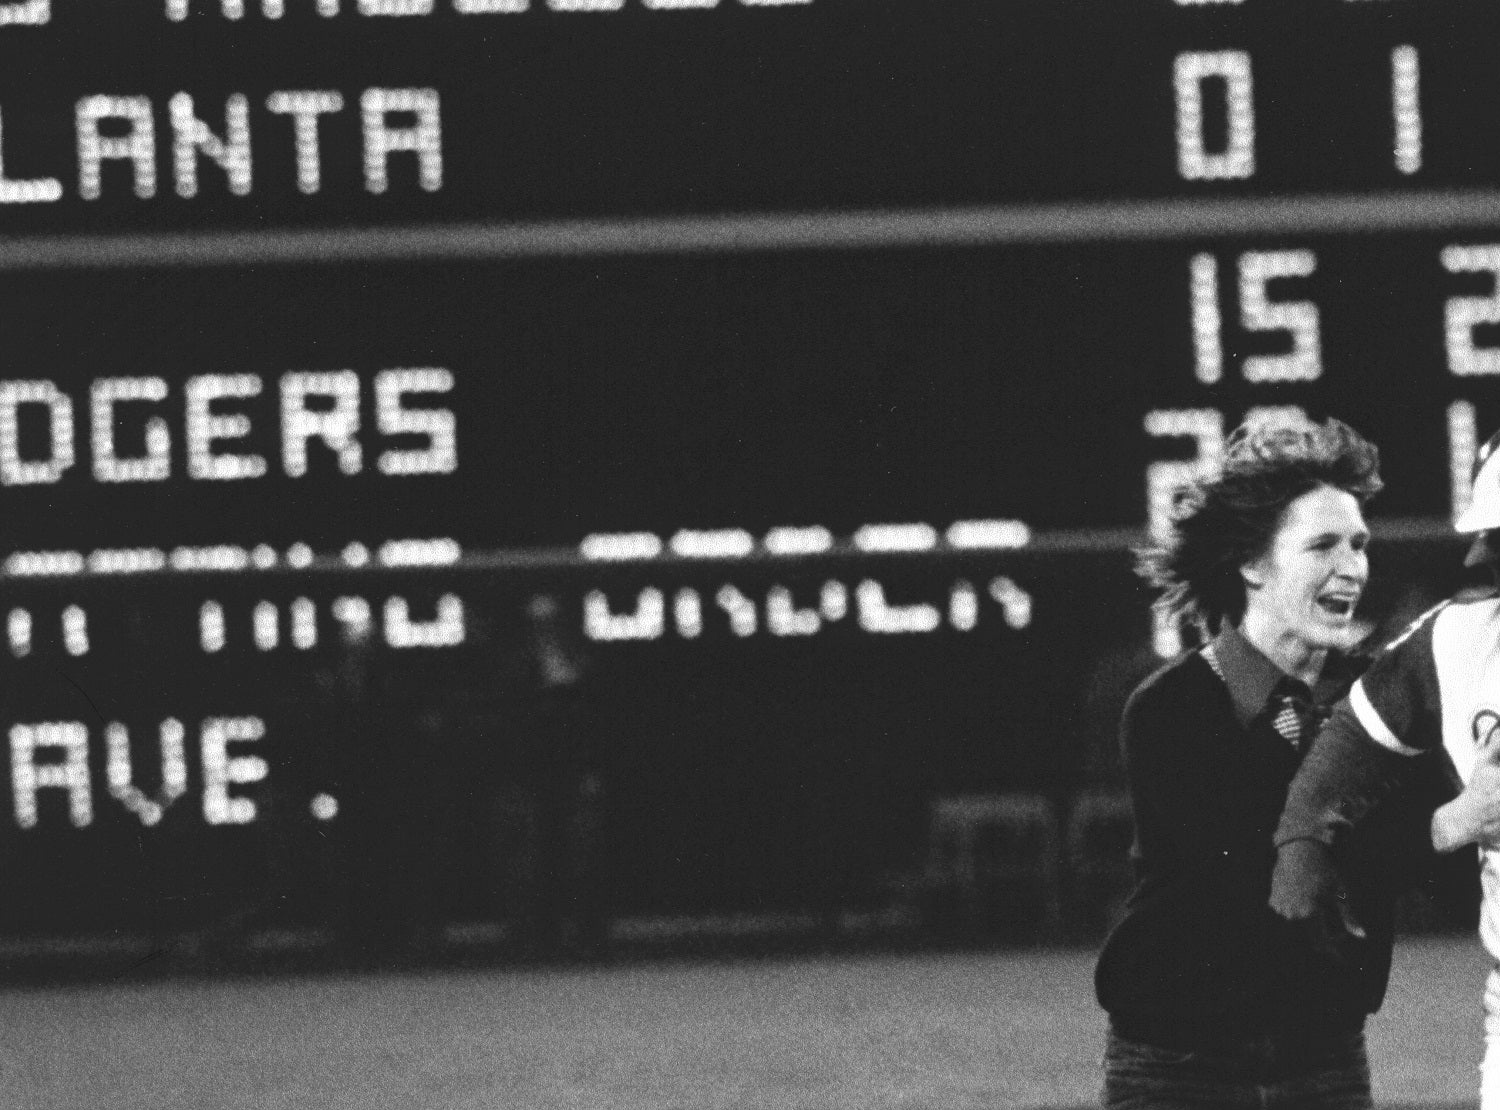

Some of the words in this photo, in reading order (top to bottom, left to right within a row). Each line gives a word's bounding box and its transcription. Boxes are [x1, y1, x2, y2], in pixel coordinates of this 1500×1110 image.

[1392, 45, 1422, 174] 1
[1191, 250, 1322, 384] 15
[9, 717, 338, 827] AVE.
